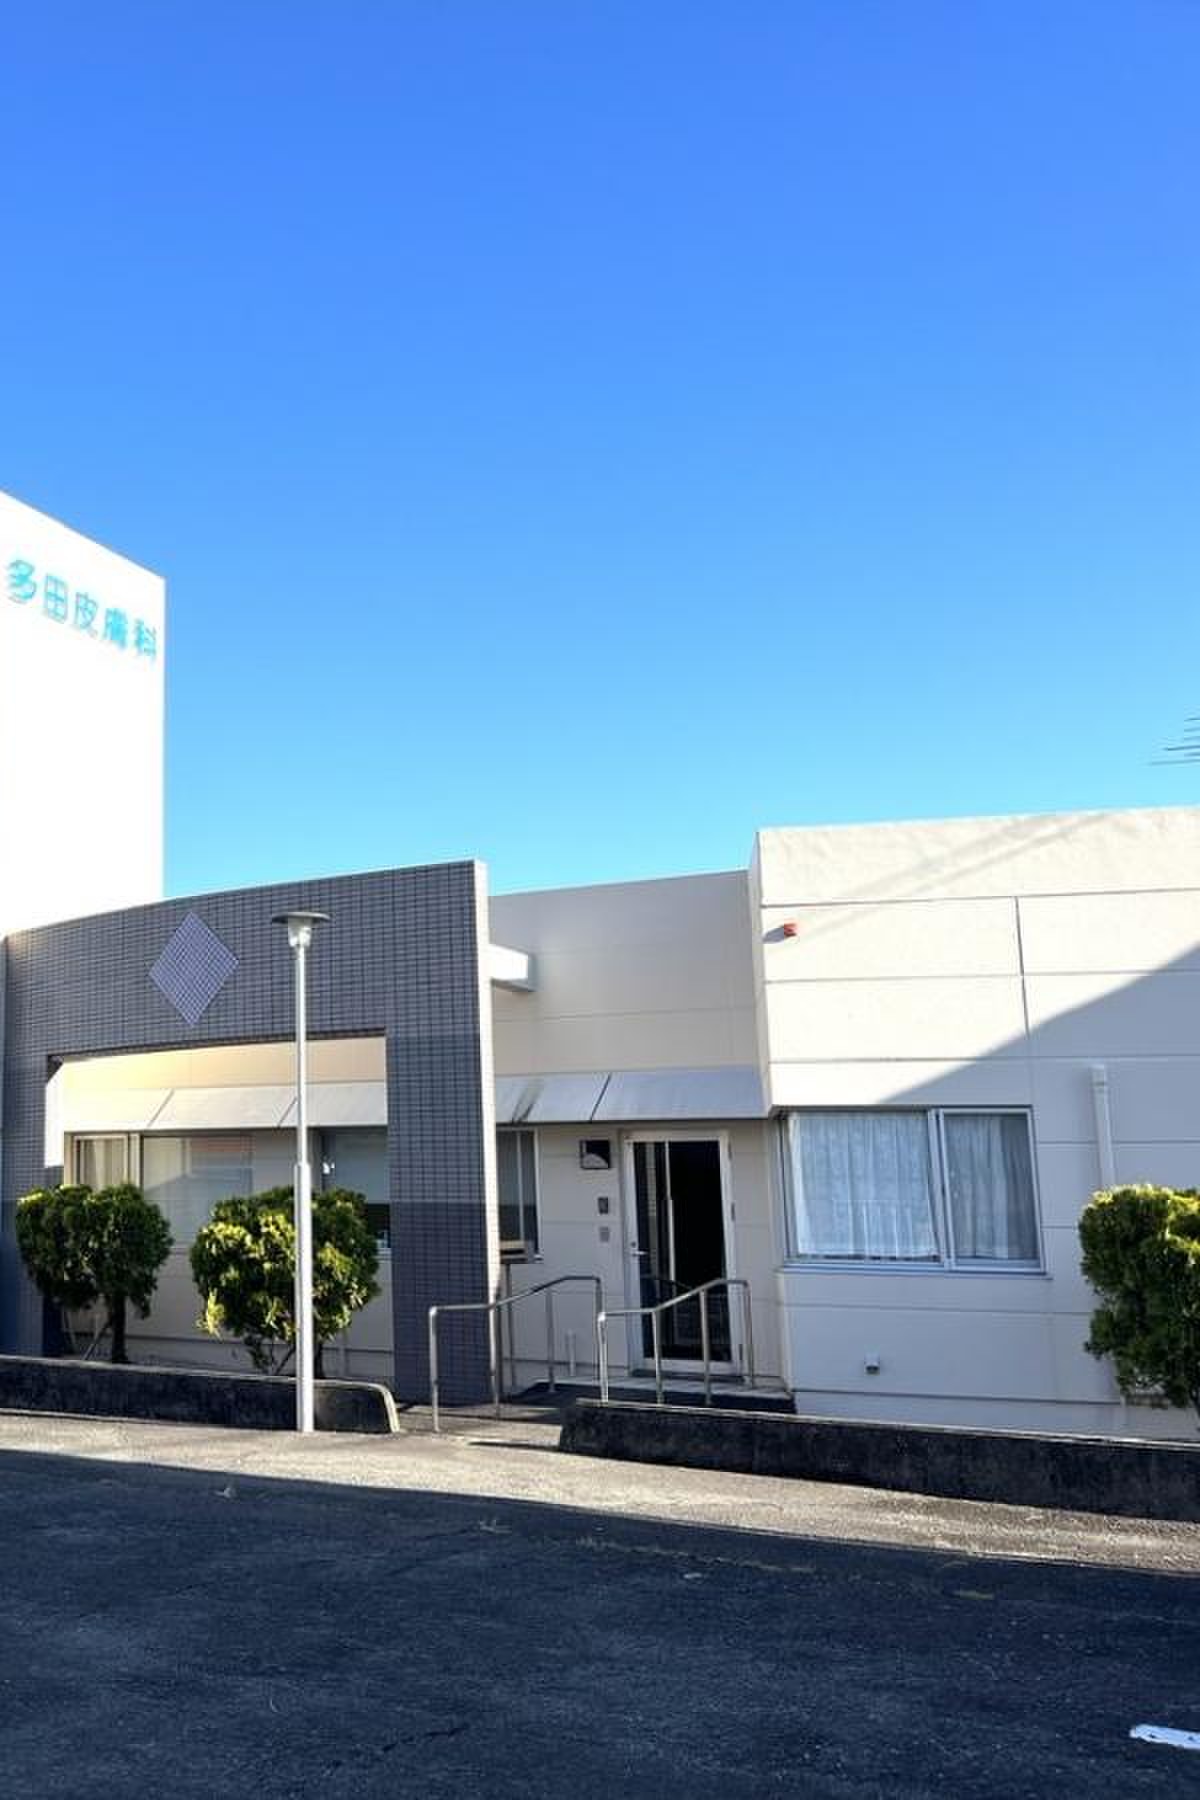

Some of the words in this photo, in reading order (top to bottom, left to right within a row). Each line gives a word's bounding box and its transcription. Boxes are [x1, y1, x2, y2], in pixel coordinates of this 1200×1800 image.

[7, 559, 158, 660] 多田皮膚科
